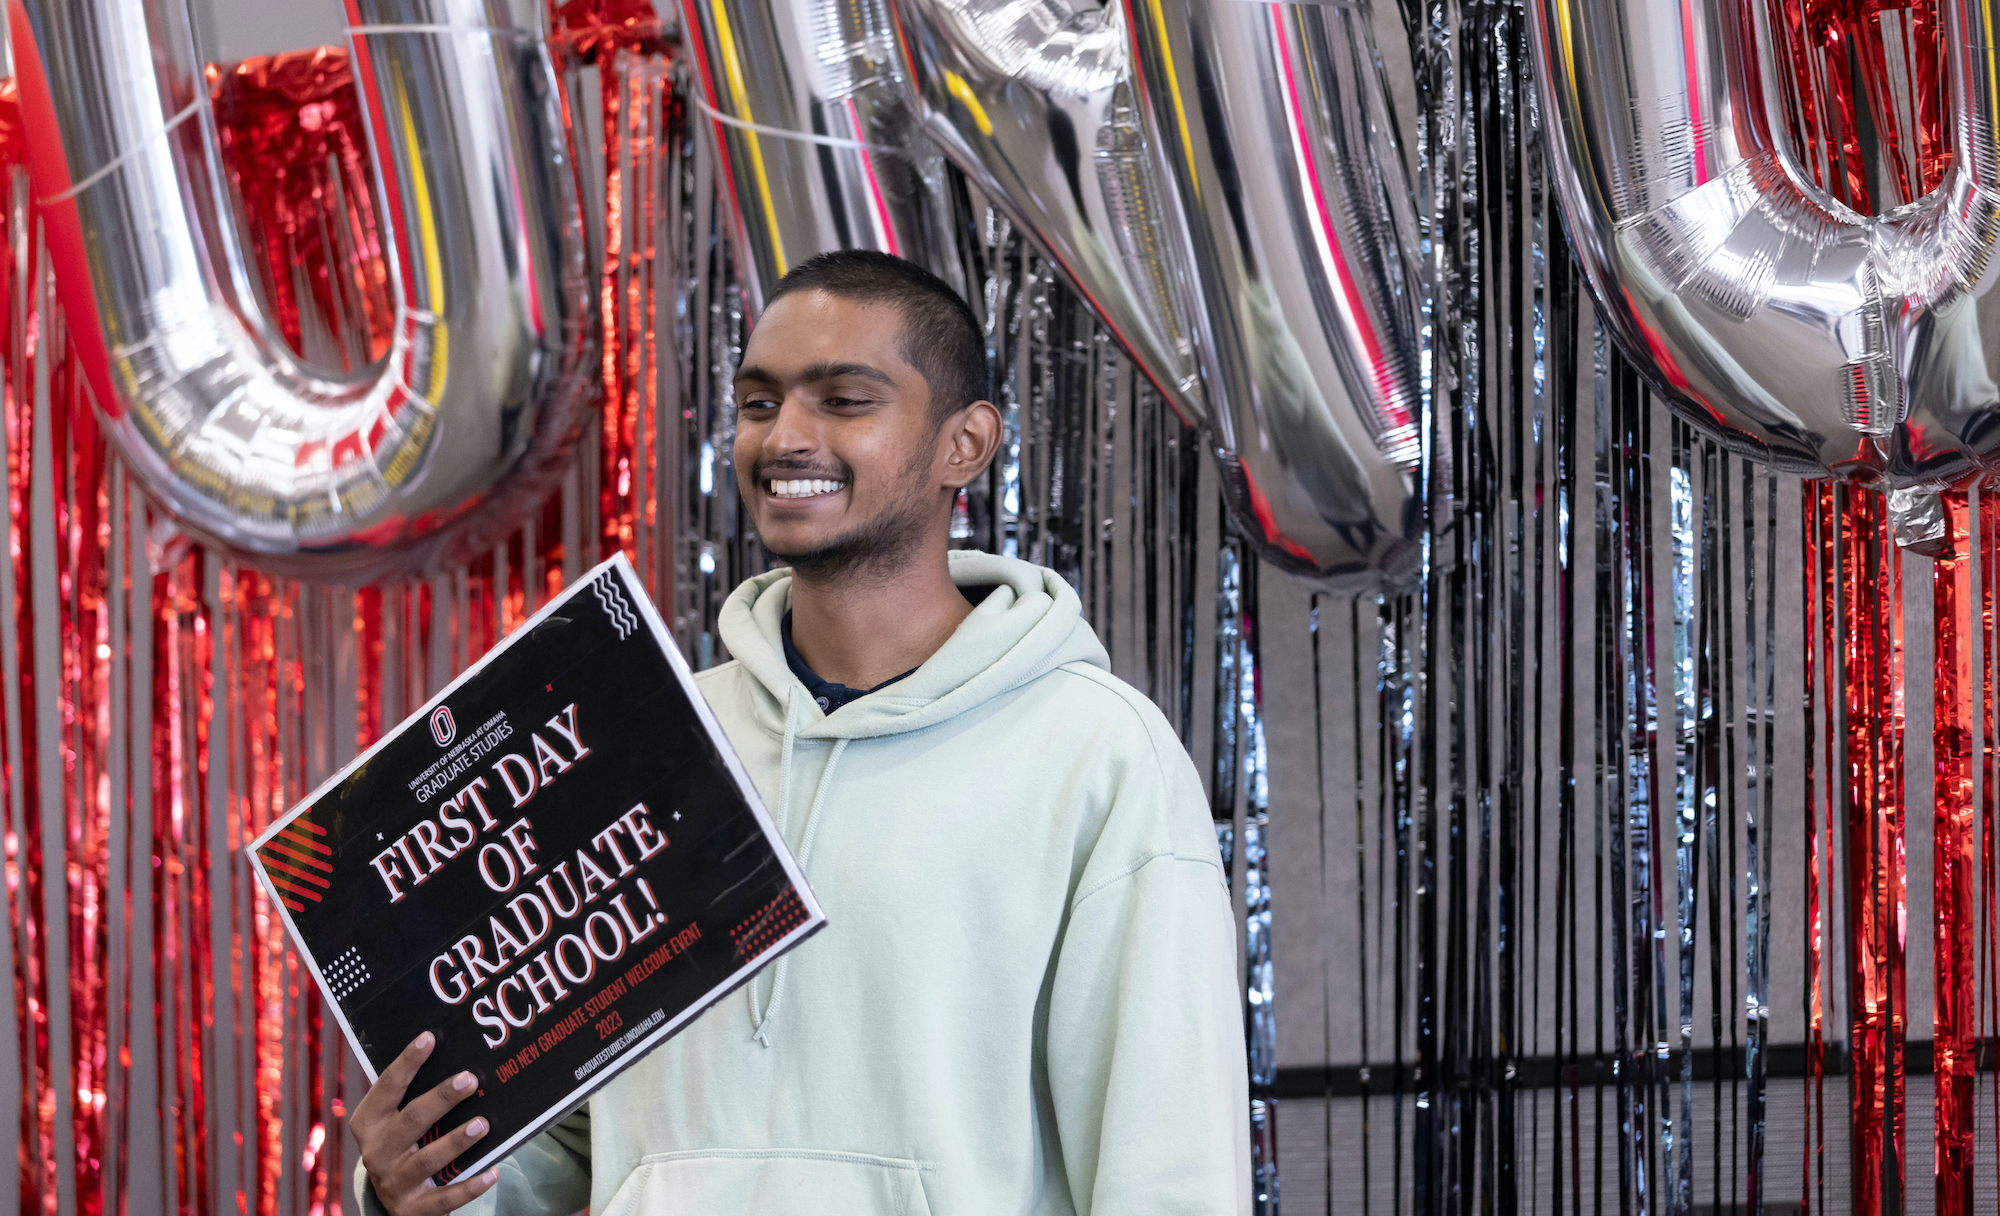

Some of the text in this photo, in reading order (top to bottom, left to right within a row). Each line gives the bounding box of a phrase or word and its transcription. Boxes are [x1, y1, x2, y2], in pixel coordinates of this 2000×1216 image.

[408, 710, 507, 790] UNIVERSITY OF NEBRASKA AT OMAHA
[416, 720, 514, 803] GRADUATE STUDIES
[369, 703, 592, 904] FIRST DAY
[477, 817, 539, 893] OF
[428, 802, 669, 1005] GRADUATE
[472, 877, 668, 1050] SCHOOL!
[495, 921, 702, 1083] UNO NEW GRADUATE STUDENT WELCOME EVENT
[574, 1008, 666, 1080] GRADUATESTUDIES.UNOMAHA.EDU
[595, 1010, 624, 1041] 2023
